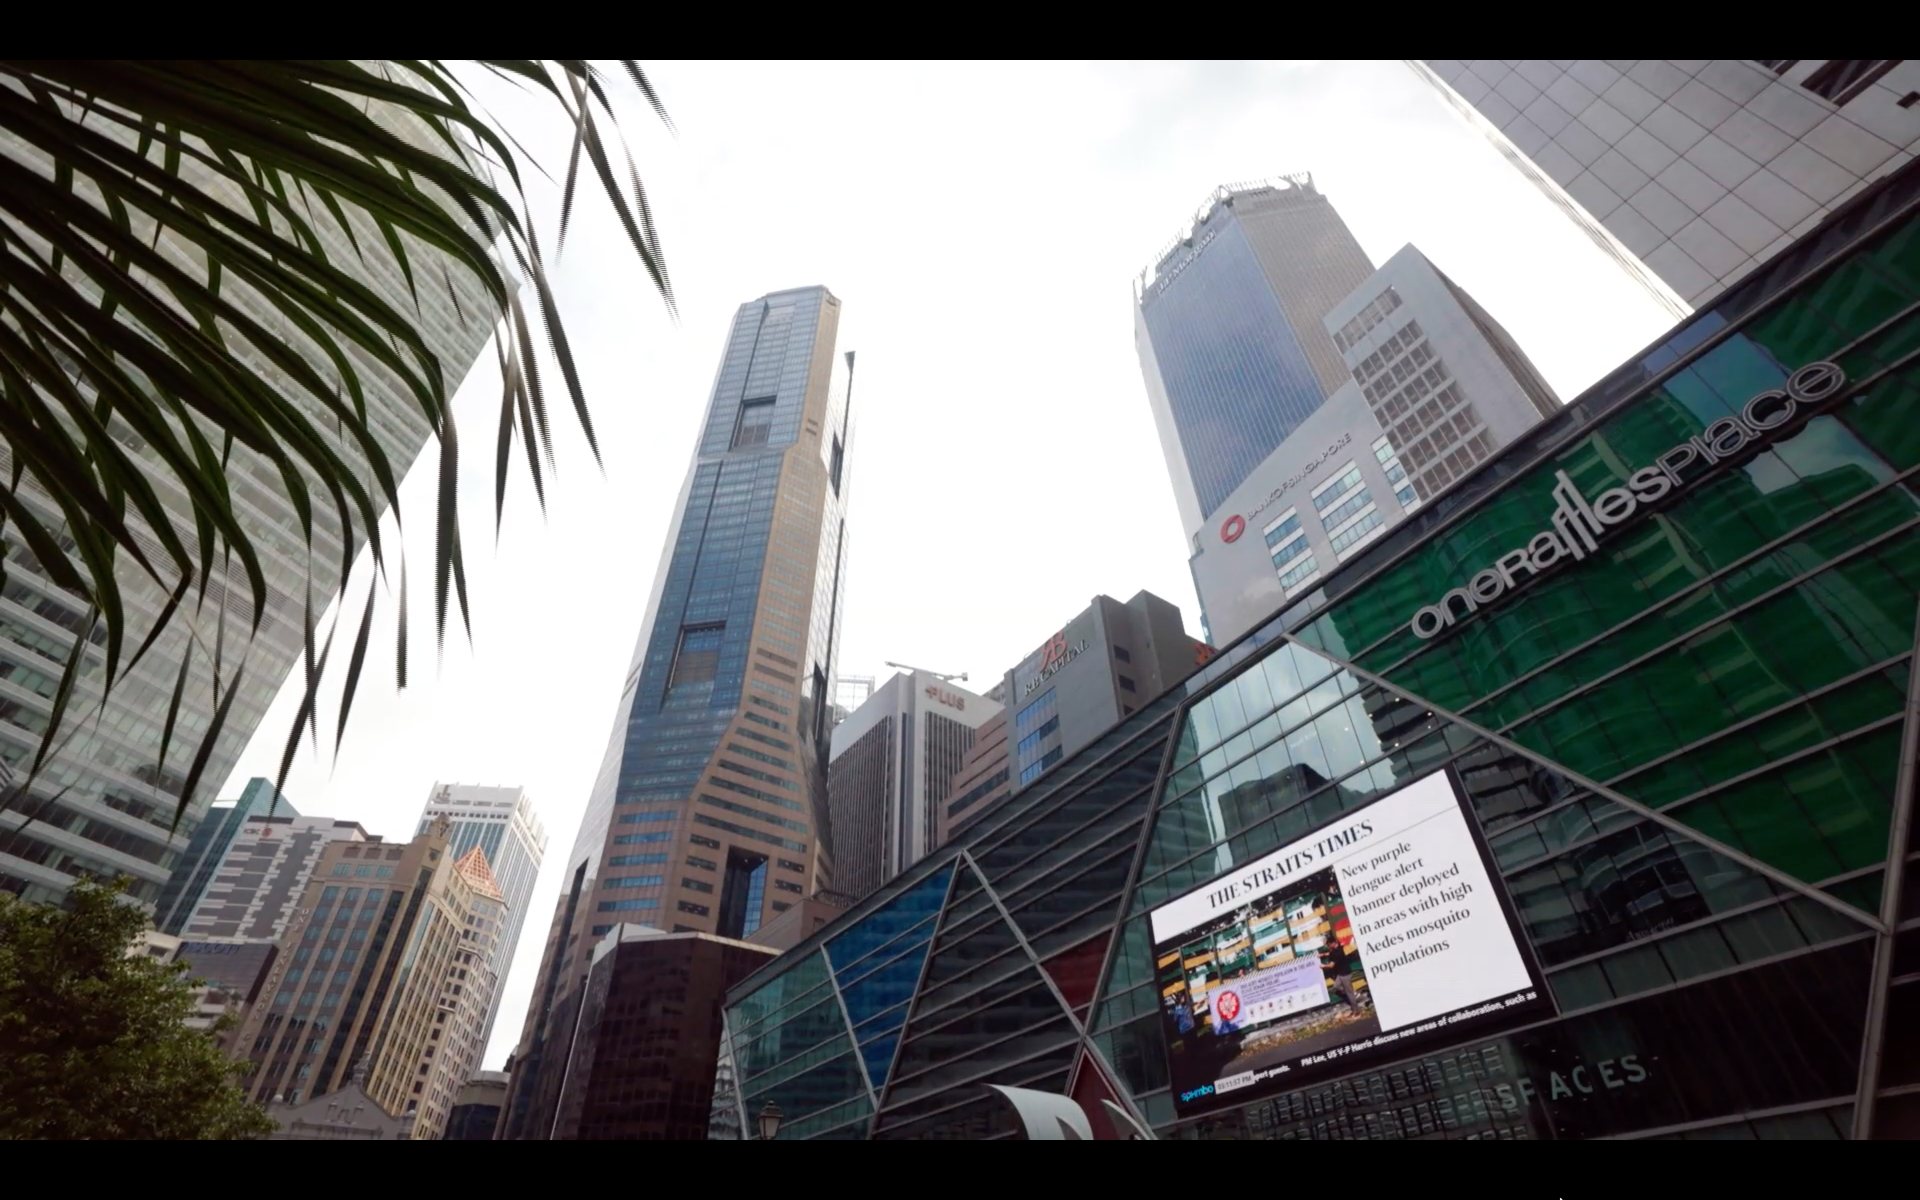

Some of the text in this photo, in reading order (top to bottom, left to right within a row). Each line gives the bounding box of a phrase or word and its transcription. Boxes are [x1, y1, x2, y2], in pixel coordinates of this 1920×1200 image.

[1039, 639, 1089, 683] CAPITAL
[1207, 819, 1374, 909] THE STRAITS TIMES
[1341, 842, 1412, 880] New purple
[1347, 858, 1424, 898] dengue alert
[1352, 862, 1460, 917] banner deployed
[1358, 882, 1473, 935] in areas with high
[1365, 908, 1471, 955] Aedes mosquito
[1370, 939, 1451, 978] populations
[1373, 1033, 1399, 1046] discuss
[1400, 1028, 1416, 1038] new
[1416, 1021, 1437, 1033] areas
[1437, 1016, 1447, 1027] of
[1505, 994, 1526, 1006] such
[1526, 991, 1538, 1001] as
[1495, 1054, 1647, 1111] SPACES
